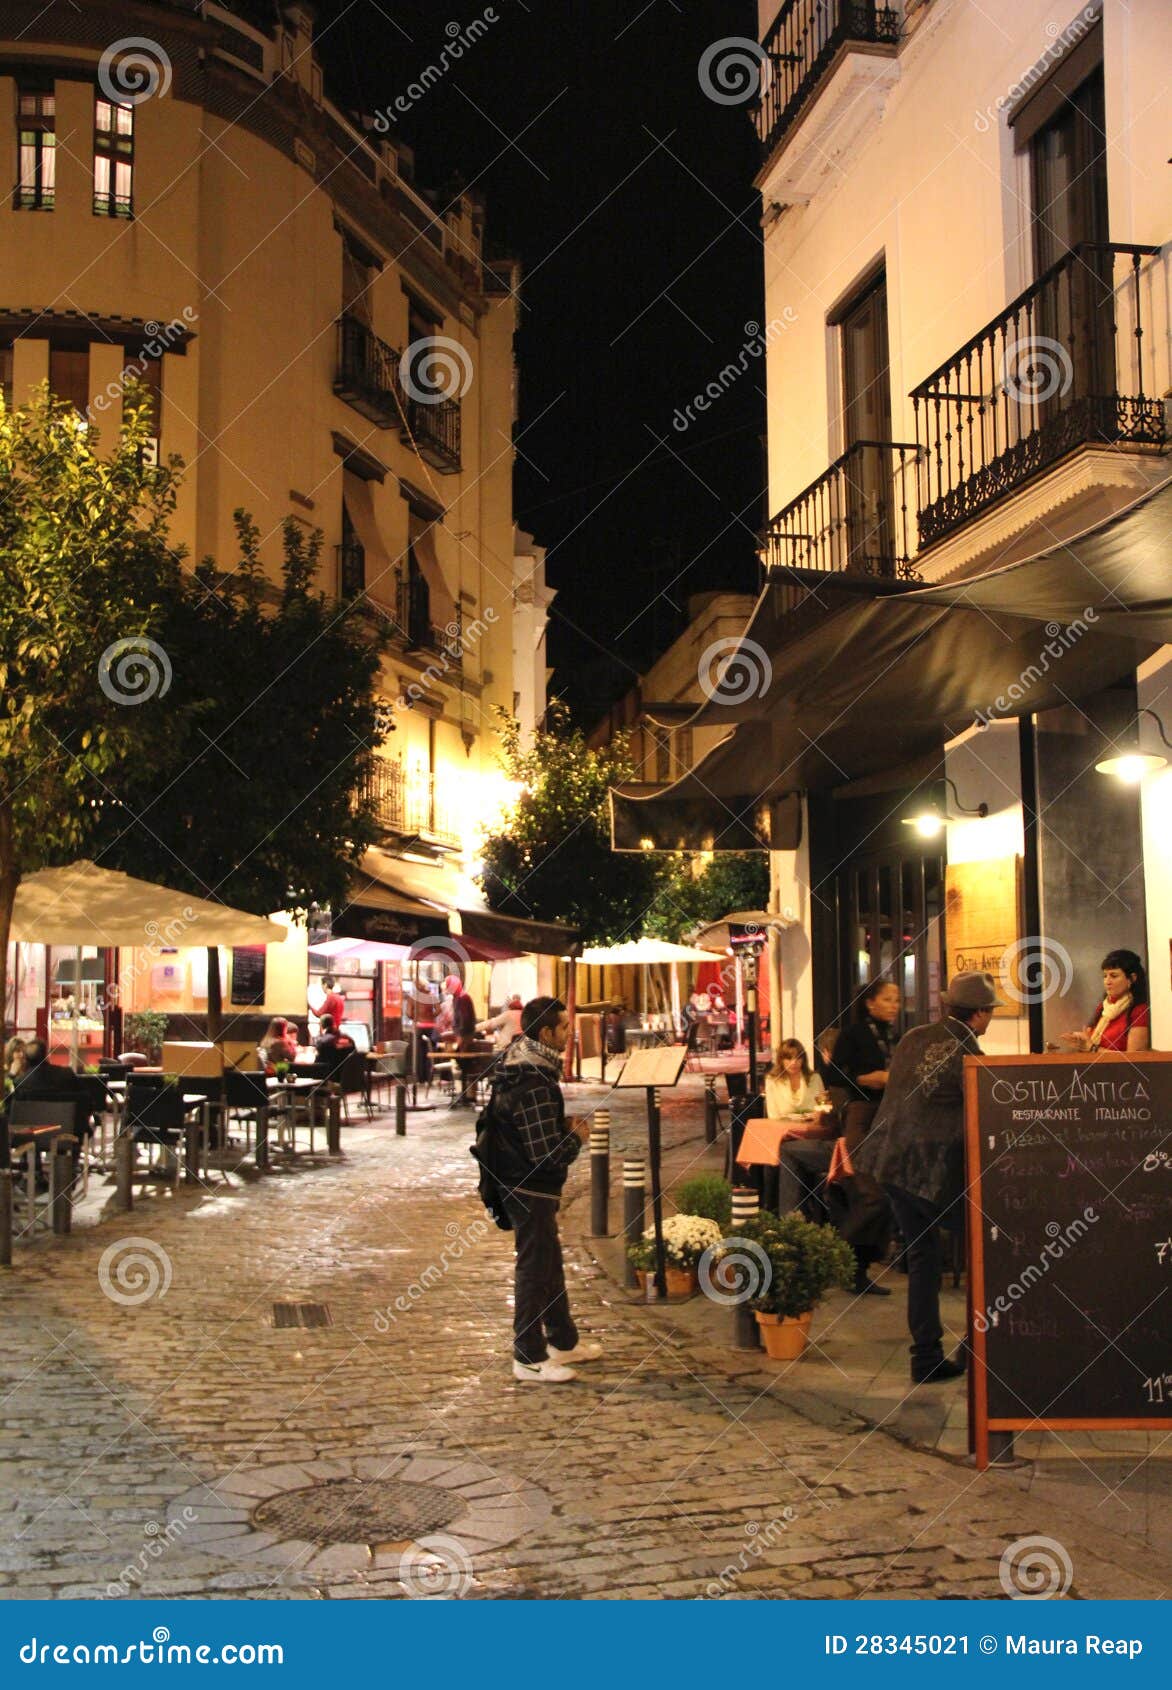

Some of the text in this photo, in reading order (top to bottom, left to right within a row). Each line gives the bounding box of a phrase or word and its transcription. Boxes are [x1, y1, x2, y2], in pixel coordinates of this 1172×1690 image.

[992, 1069, 1150, 1104] OSTIA ANTICA
[1012, 1107, 1151, 1121] RESTAURANTE ITALIANO
